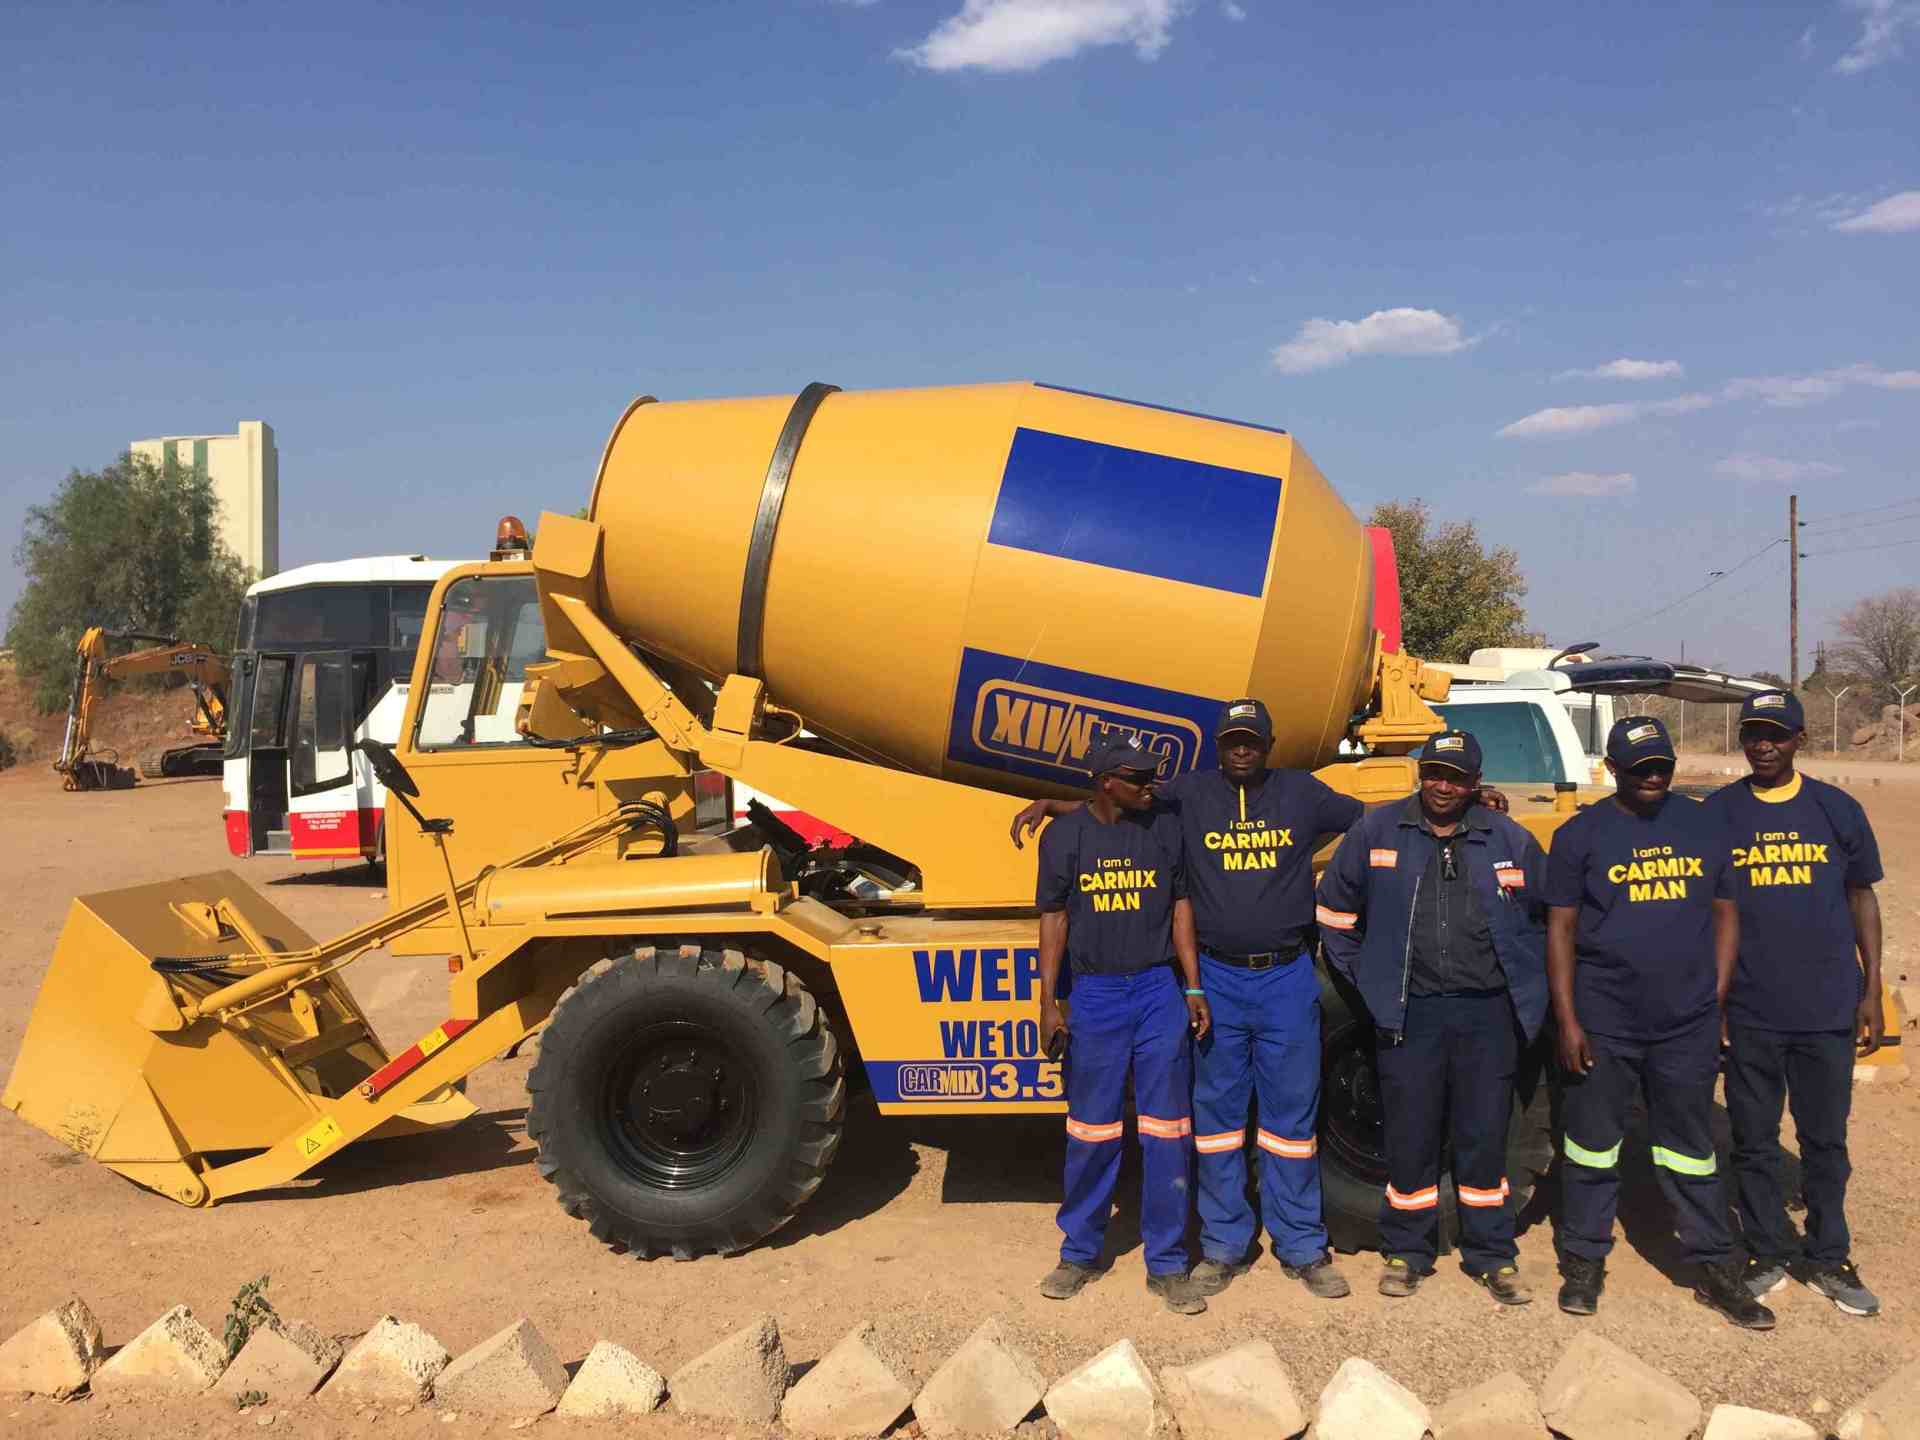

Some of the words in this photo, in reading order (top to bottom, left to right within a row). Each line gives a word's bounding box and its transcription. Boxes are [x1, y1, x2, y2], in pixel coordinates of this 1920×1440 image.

[991, 694, 1184, 784] CMIX
[1236, 822, 1254, 830] am
[1257, 820, 1265, 828] a
[1204, 829, 1293, 850] CARMIX
[1763, 832, 1785, 841] am
[1788, 832, 1799, 840] a
[1223, 851, 1277, 870] MAN
[1640, 847, 1660, 858] am
[1662, 846, 1672, 855] a
[1732, 843, 1829, 867] CARMIX
[1103, 859, 1121, 868] am
[1124, 858, 1131, 867] a
[1608, 857, 1704, 884] CARMIX
[1080, 870, 1157, 891] CARMIX
[1751, 865, 1812, 886] MAN
[1629, 880, 1687, 902] MAN
[1093, 892, 1140, 912] MAN
[904, 1067, 980, 1095] CARMIX
[990, 1063, 1064, 1098] 3.5
